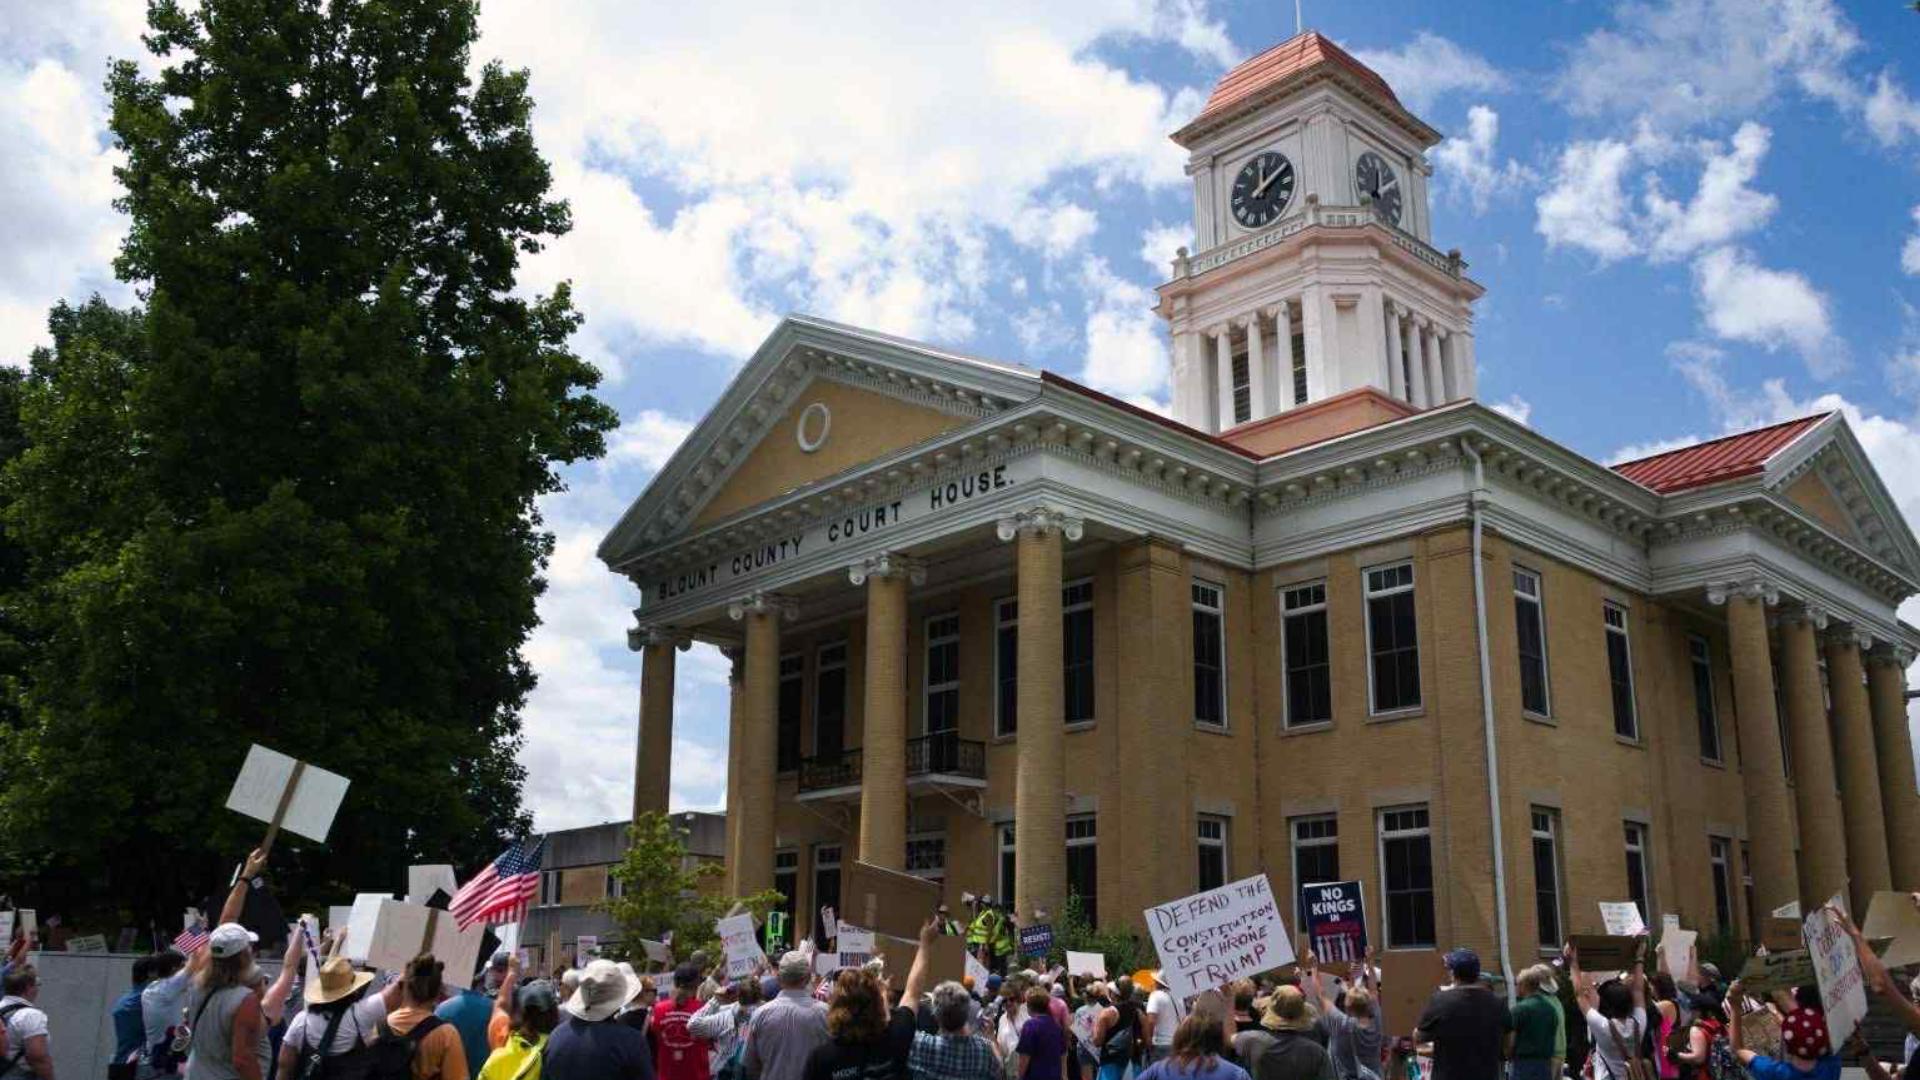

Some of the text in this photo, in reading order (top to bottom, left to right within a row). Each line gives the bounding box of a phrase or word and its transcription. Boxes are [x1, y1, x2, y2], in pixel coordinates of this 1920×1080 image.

[659, 465, 1015, 600] BLOUNT COUNTY COURT HOUSE.
[1154, 879, 1267, 934] DEFEND THE
[1312, 899, 1356, 916] KINGS
[1320, 887, 1343, 901] NO
[1163, 902, 1273, 953] CONSTITUTION
[1330, 913, 1340, 922] IN
[1177, 925, 1268, 969] DETHRONE
[1186, 943, 1266, 989] TRUMP
